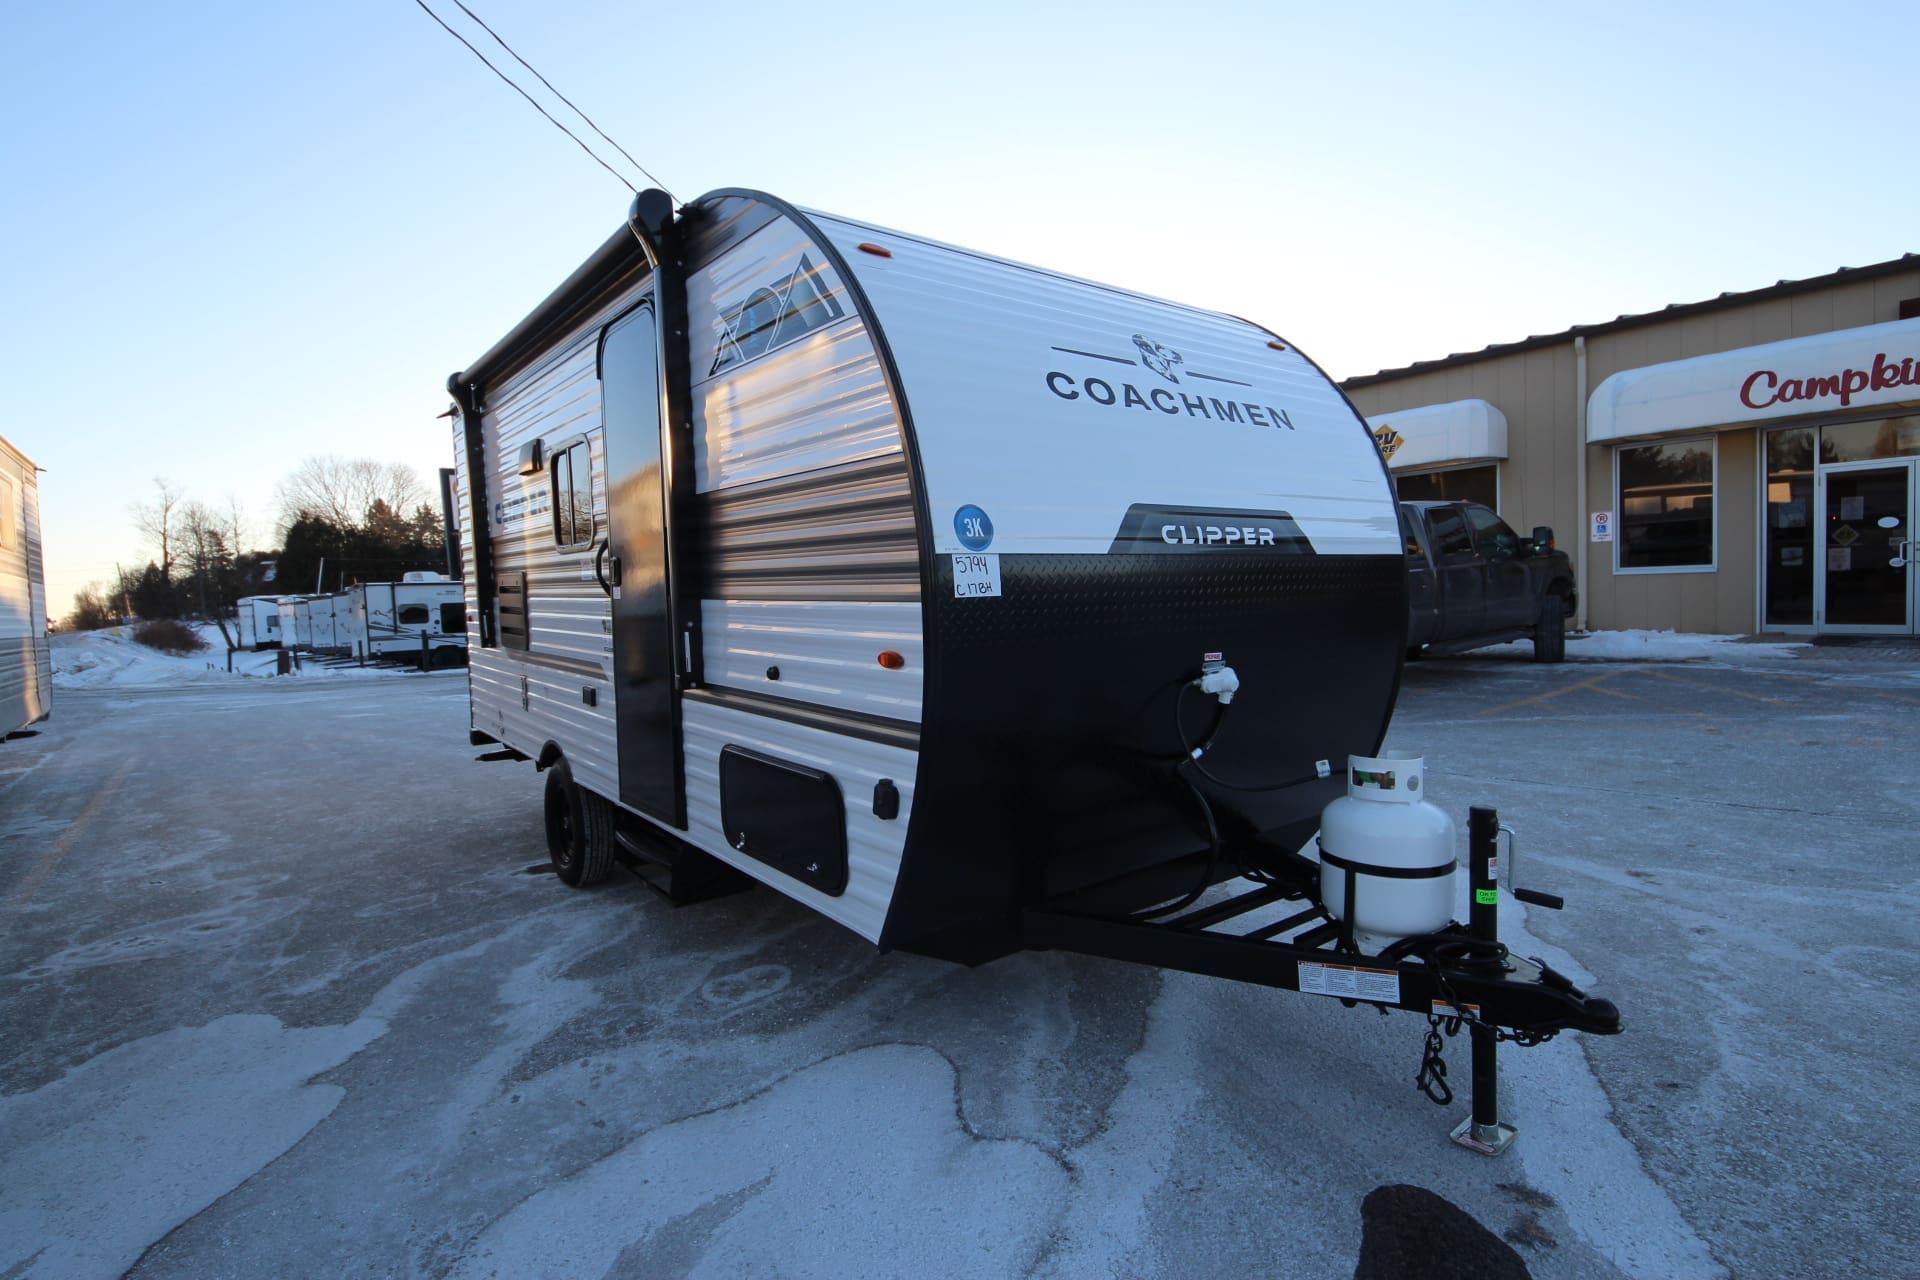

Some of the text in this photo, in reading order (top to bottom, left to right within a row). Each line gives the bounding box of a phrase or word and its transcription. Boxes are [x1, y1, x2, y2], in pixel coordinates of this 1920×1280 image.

[1046, 371, 1295, 430] COACHMEN
[963, 518, 985, 537] 3K
[1161, 525, 1275, 546] CLIPPER
[955, 556, 989, 575] 5794
